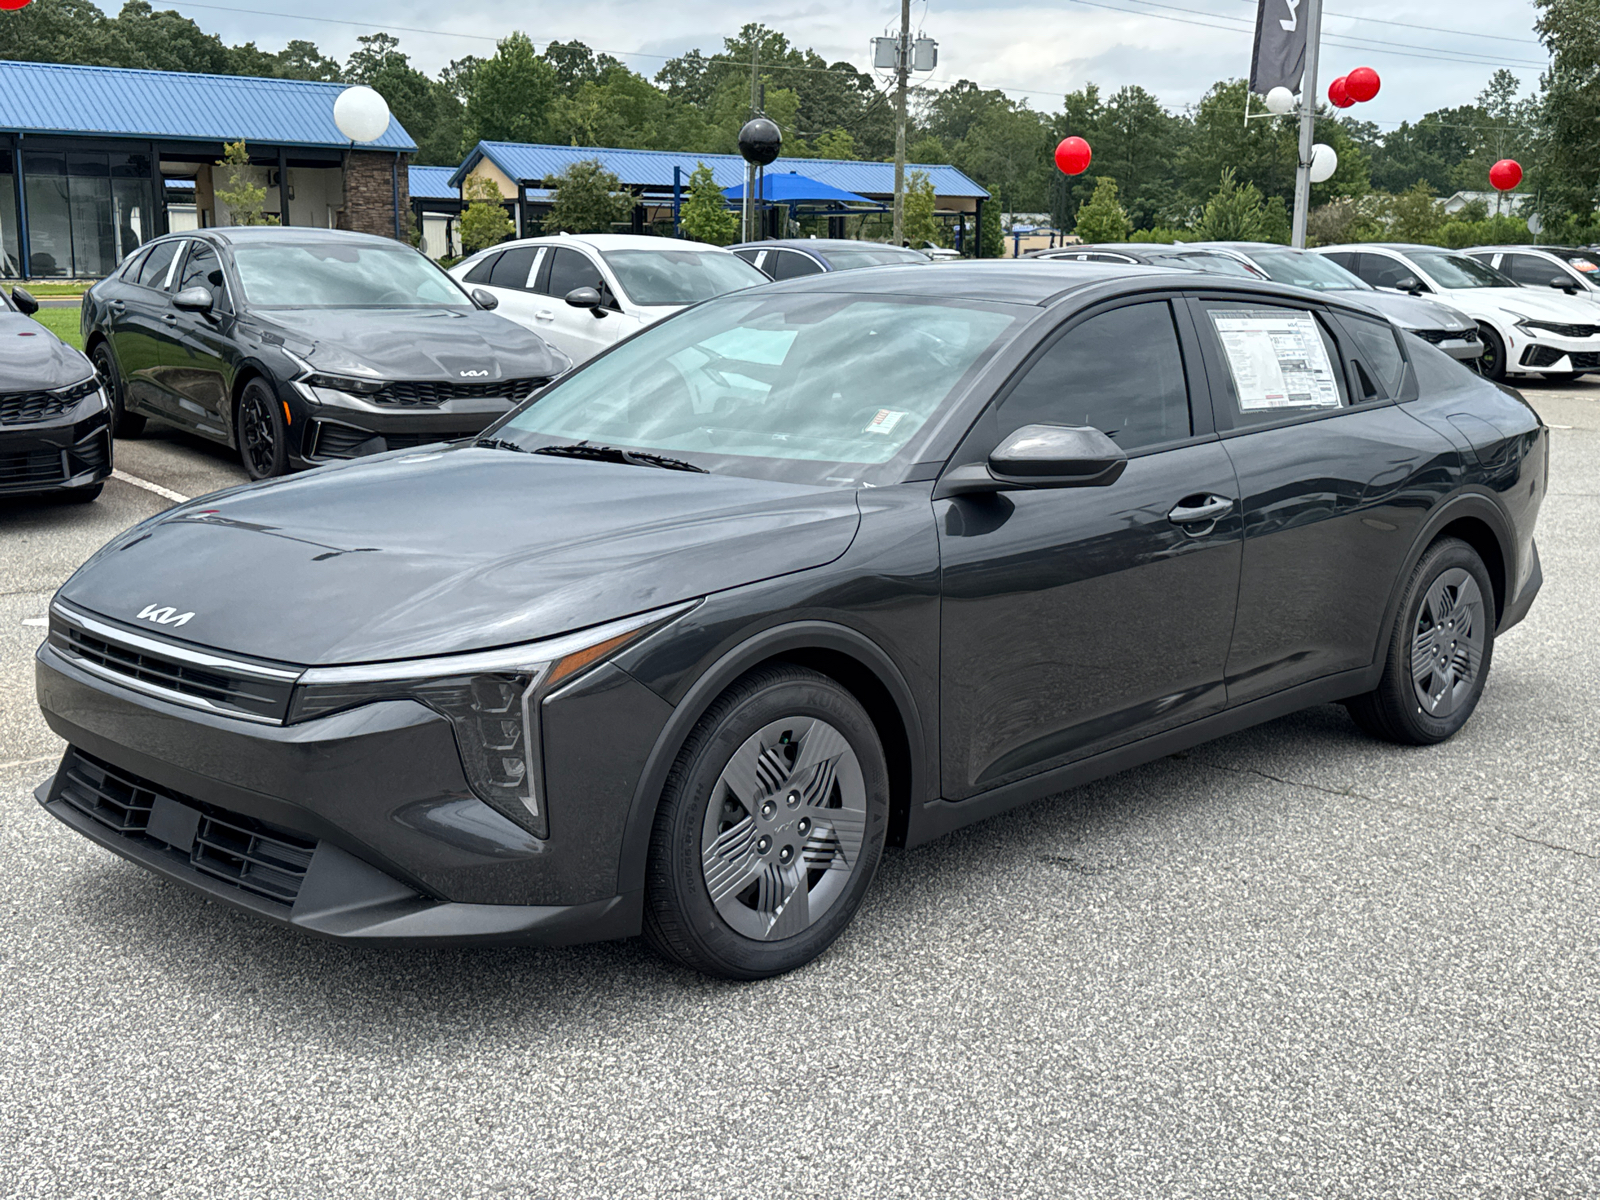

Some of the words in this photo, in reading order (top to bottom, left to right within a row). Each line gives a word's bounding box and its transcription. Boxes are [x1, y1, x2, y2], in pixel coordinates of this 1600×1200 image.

[460, 369, 489, 377] KIA
[136, 603, 196, 628] KIA
[806, 689, 861, 733] KUMHO
[684, 848, 696, 895] 205/55
